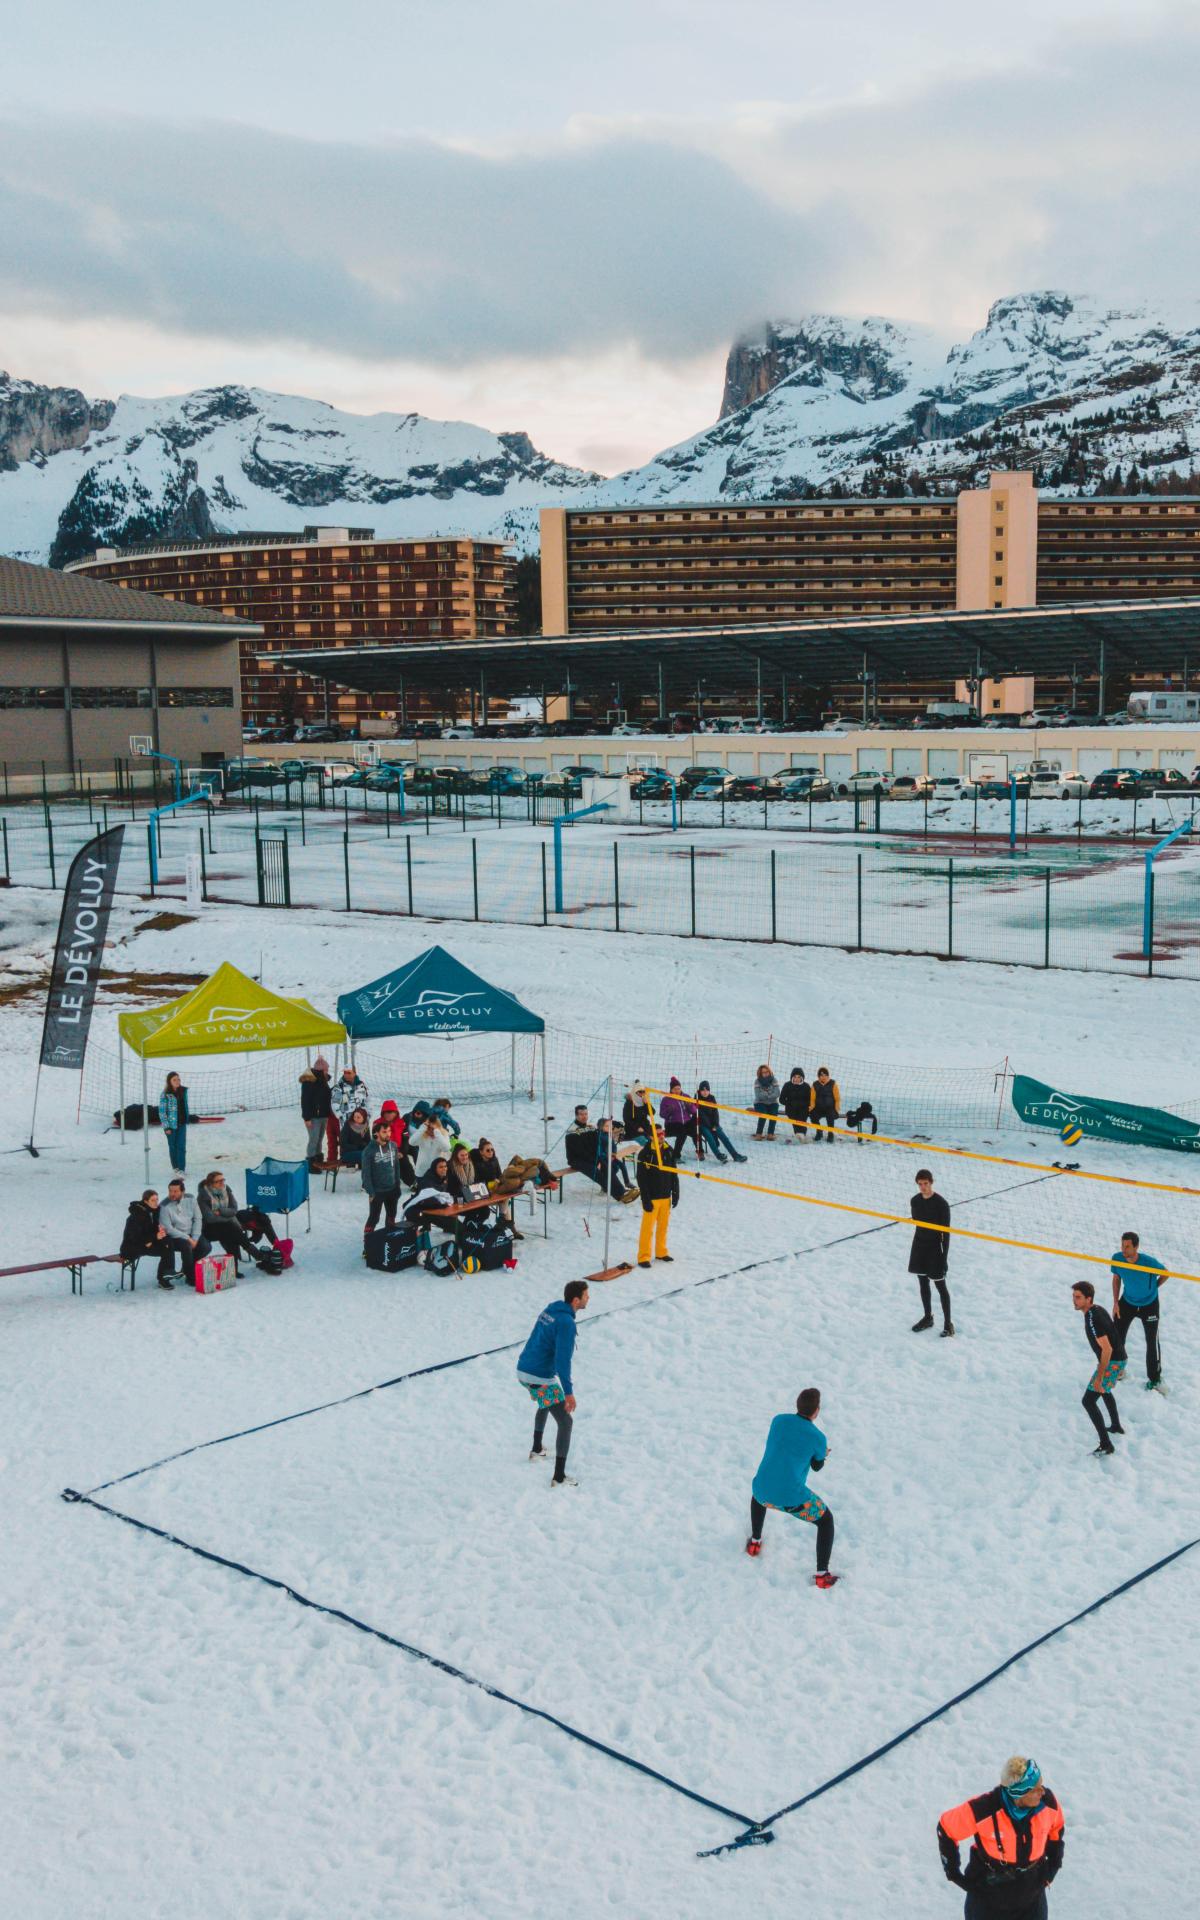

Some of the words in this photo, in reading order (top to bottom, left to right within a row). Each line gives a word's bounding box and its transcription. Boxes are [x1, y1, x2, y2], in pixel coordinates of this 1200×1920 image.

[64, 857, 107, 985] DÉVOLUY
[59, 994, 84, 1023] LE
[388, 1010, 406, 1019] LE
[414, 1007, 492, 1018] DÉVOLUY
[179, 1027, 198, 1035] LE
[206, 1020, 288, 1033] DÉVOLUY
[1024, 1105, 1038, 1116] LE
[1043, 1108, 1102, 1128] DÉVOLUY
[1172, 1137, 1186, 1146] LE
